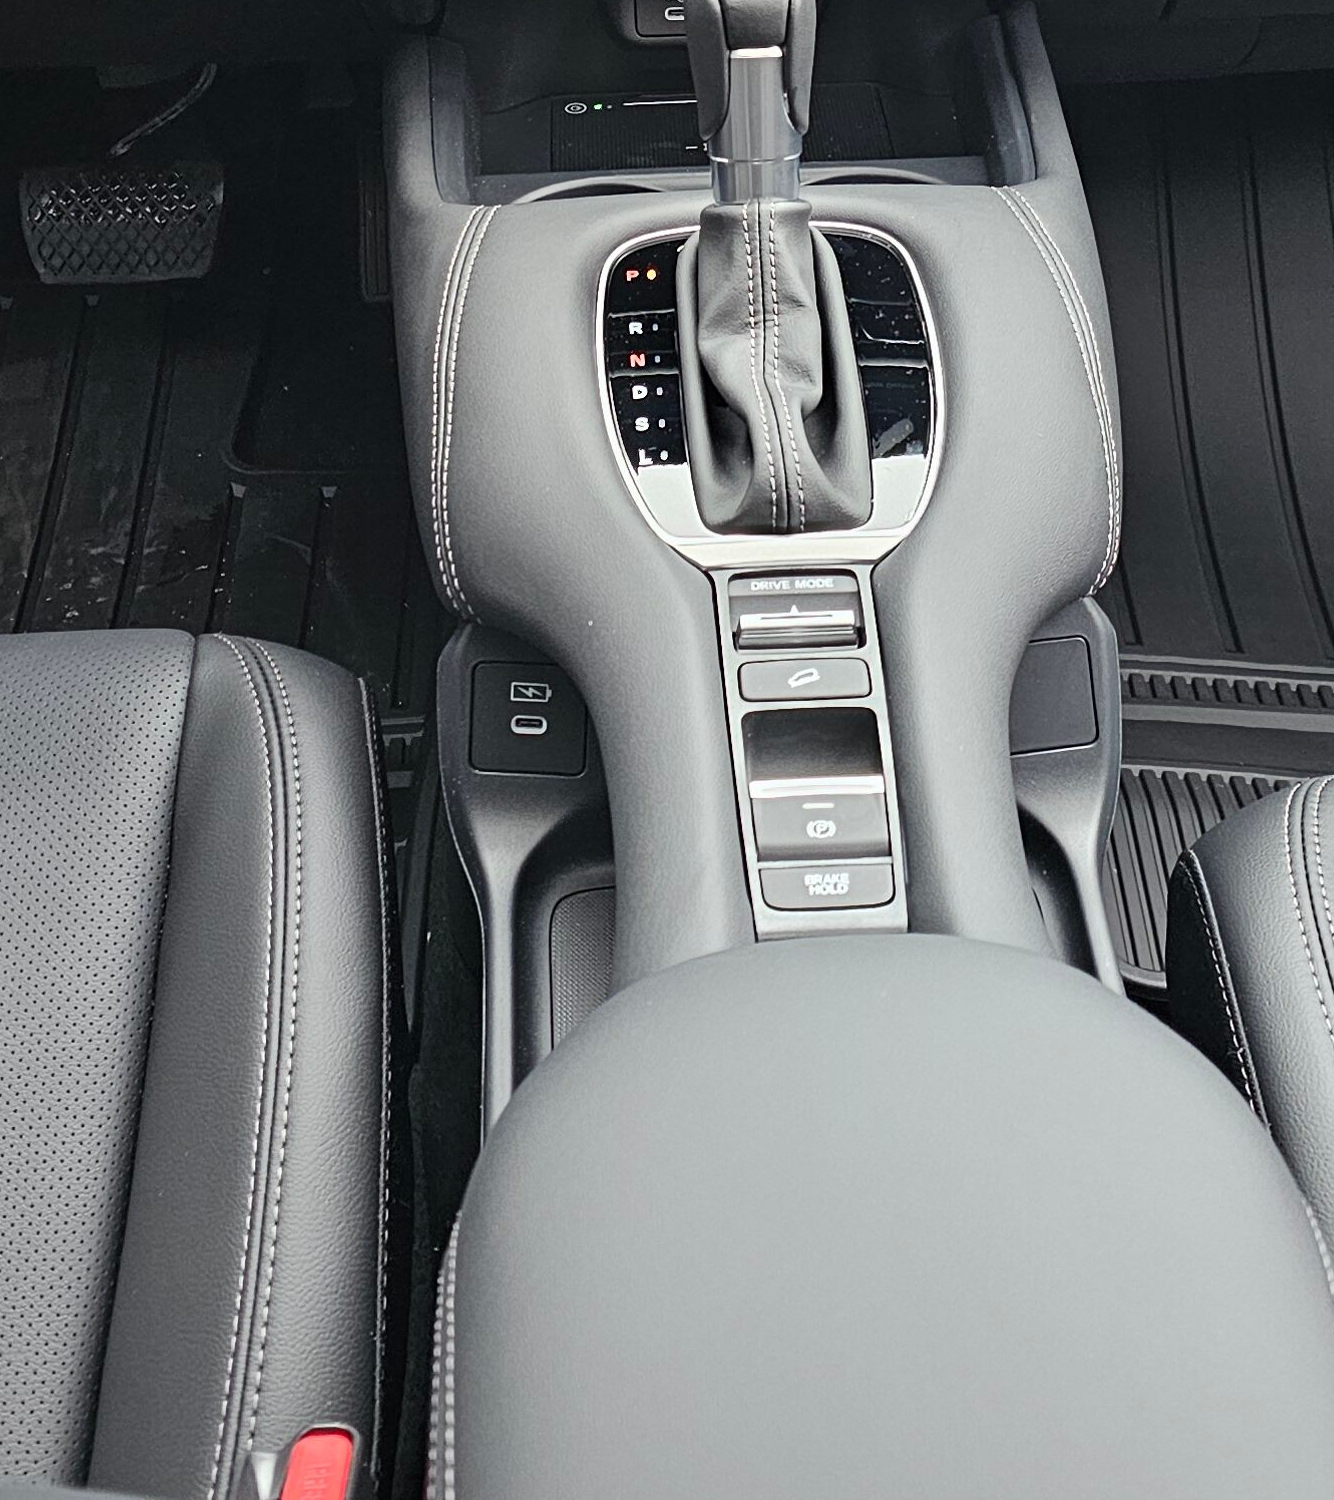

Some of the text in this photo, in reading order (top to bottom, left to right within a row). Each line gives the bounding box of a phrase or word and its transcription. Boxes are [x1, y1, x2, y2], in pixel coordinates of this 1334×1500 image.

[626, 270, 639, 281] P
[629, 322, 643, 335] R
[630, 353, 646, 368] N
[632, 385, 648, 399] D
[635, 417, 649, 431] S
[639, 449, 653, 465] L
[751, 578, 834, 591] DRIVE MODE
[804, 873, 849, 886] BRAKE
[808, 884, 848, 896] HOLD
